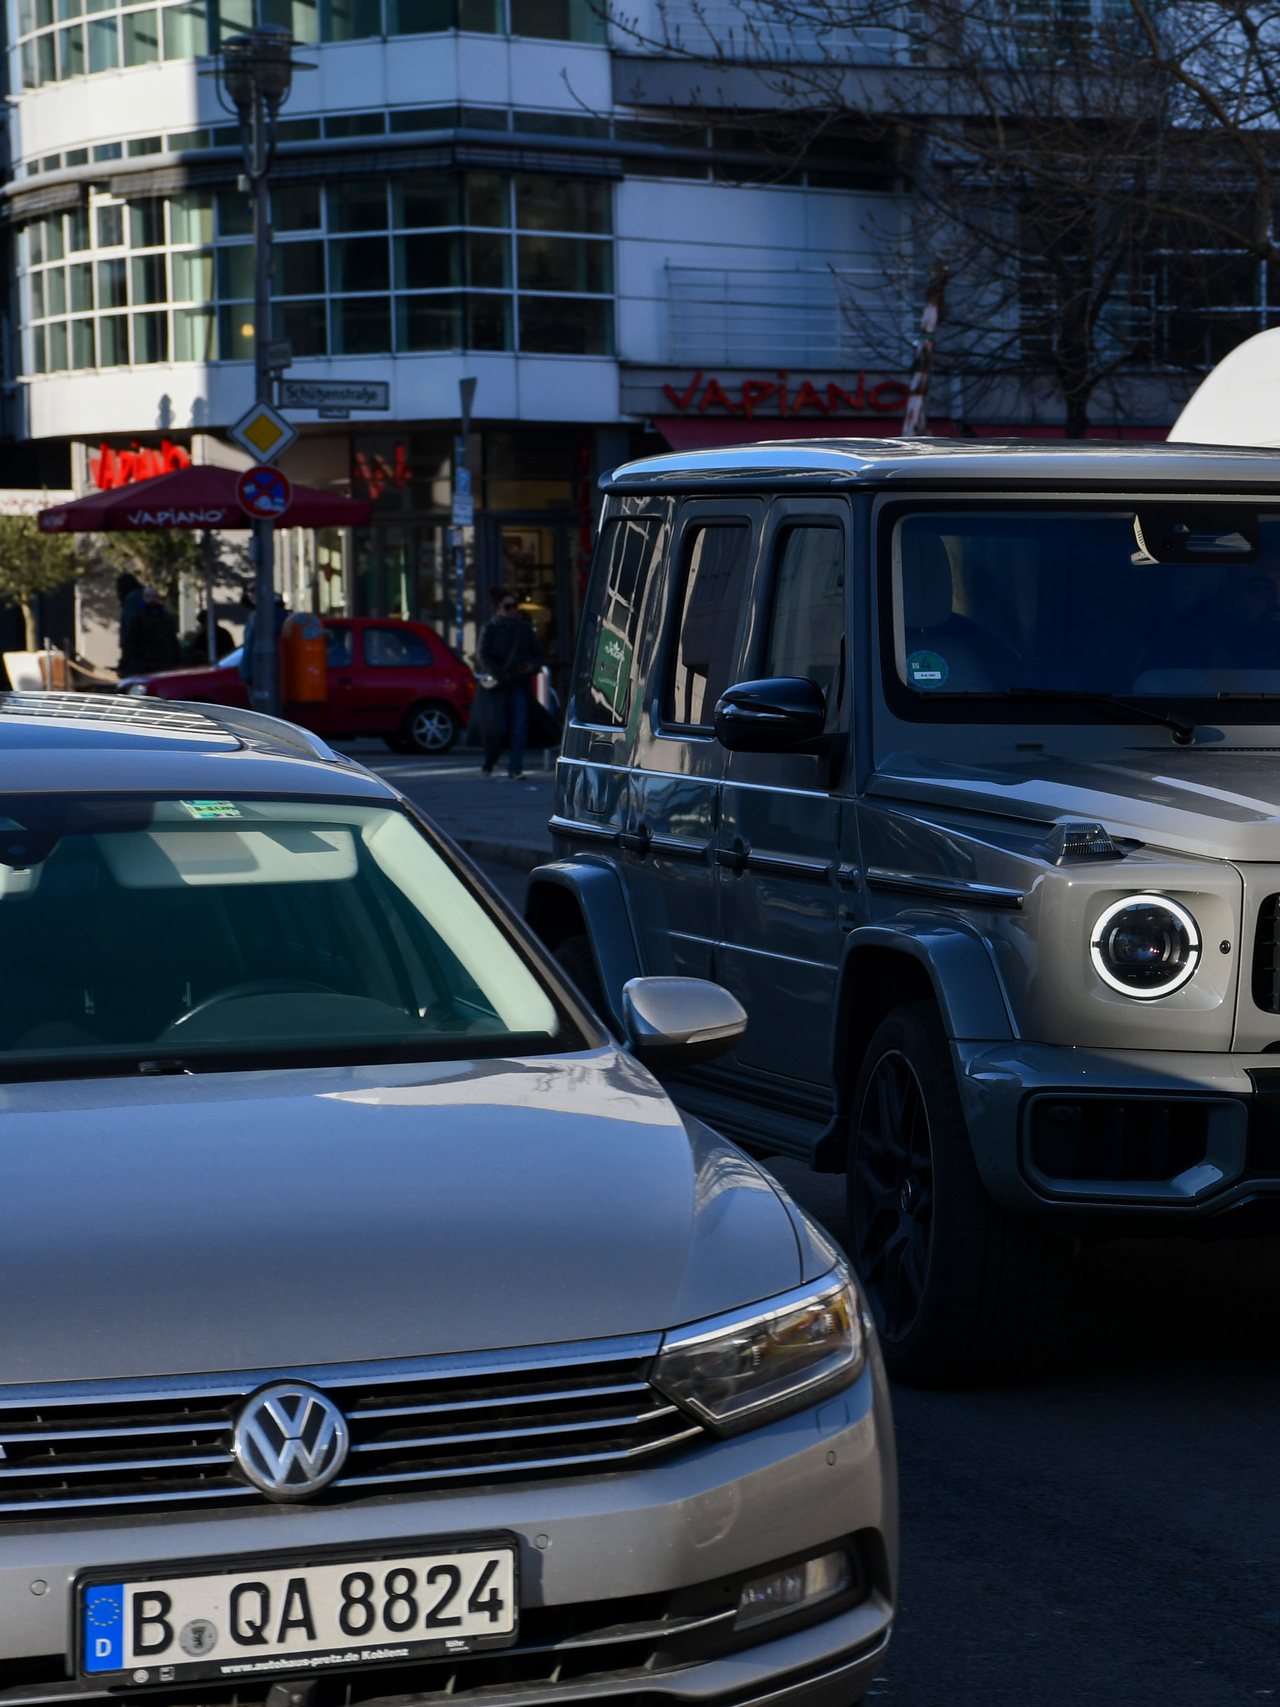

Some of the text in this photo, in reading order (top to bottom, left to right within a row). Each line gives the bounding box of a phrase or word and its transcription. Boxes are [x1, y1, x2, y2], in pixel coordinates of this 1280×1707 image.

[920, 655, 932, 670] 4
[94, 1560, 505, 1657] D B QA 8824
[361, 1647, 410, 1661] Koblenz
